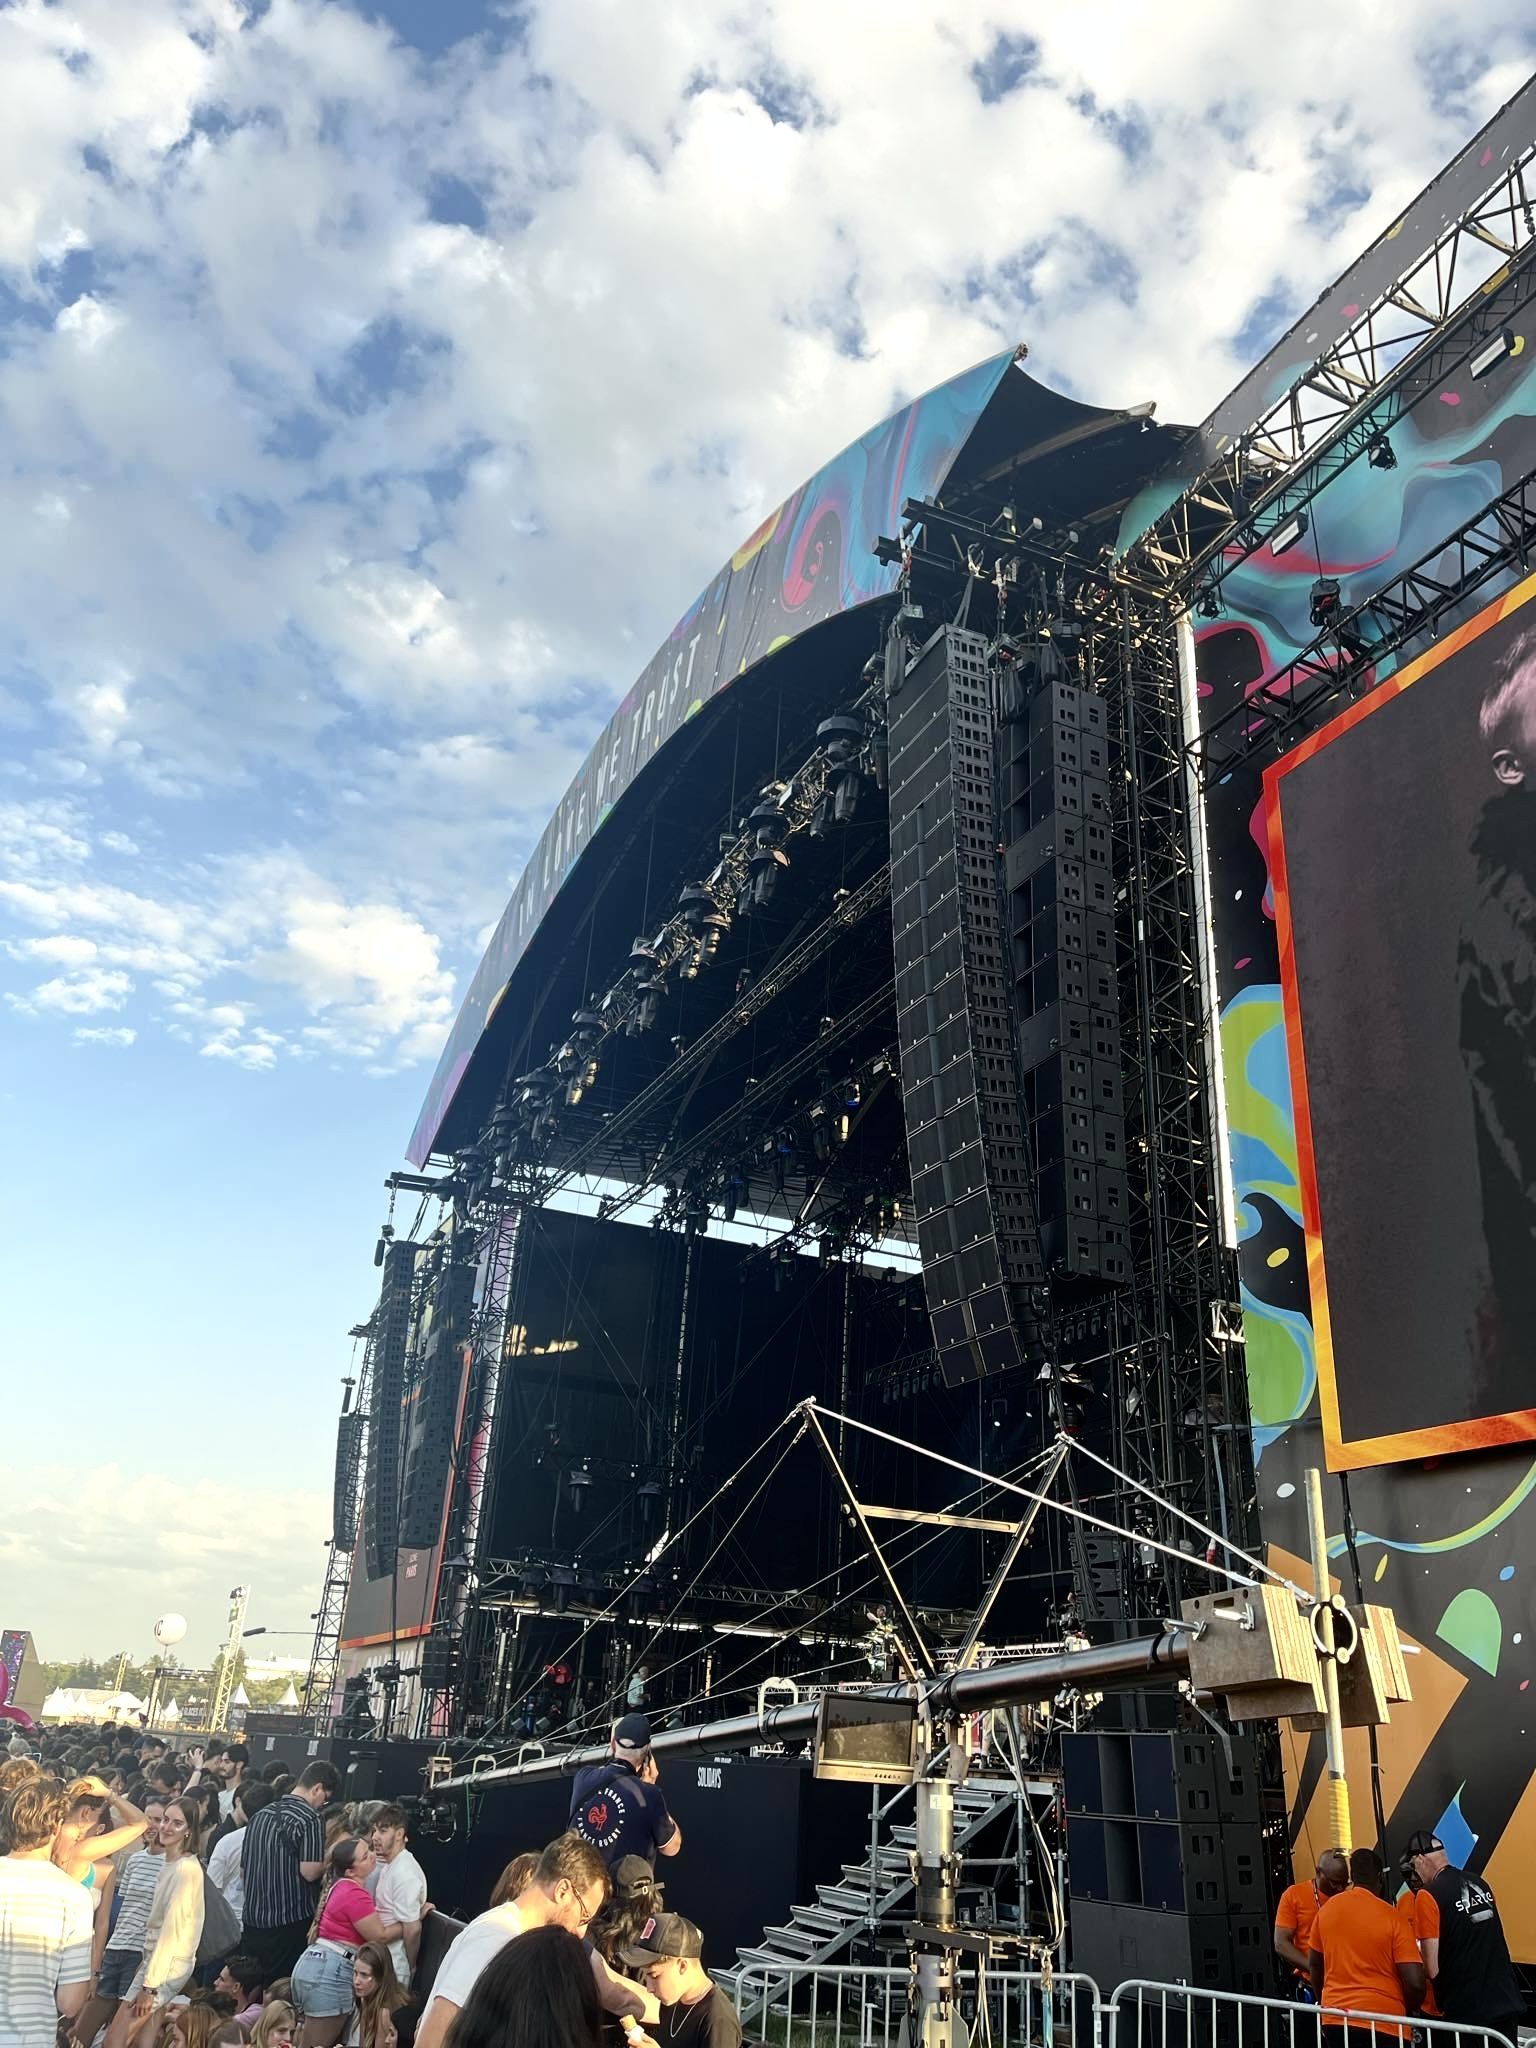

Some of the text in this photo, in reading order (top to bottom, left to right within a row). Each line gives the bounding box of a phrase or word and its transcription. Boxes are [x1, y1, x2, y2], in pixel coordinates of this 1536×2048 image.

[519, 632, 701, 936] IN LOVE WE TRUST
[604, 1787, 625, 1814] FRANCE
[598, 1828, 621, 1847] RUGBY
